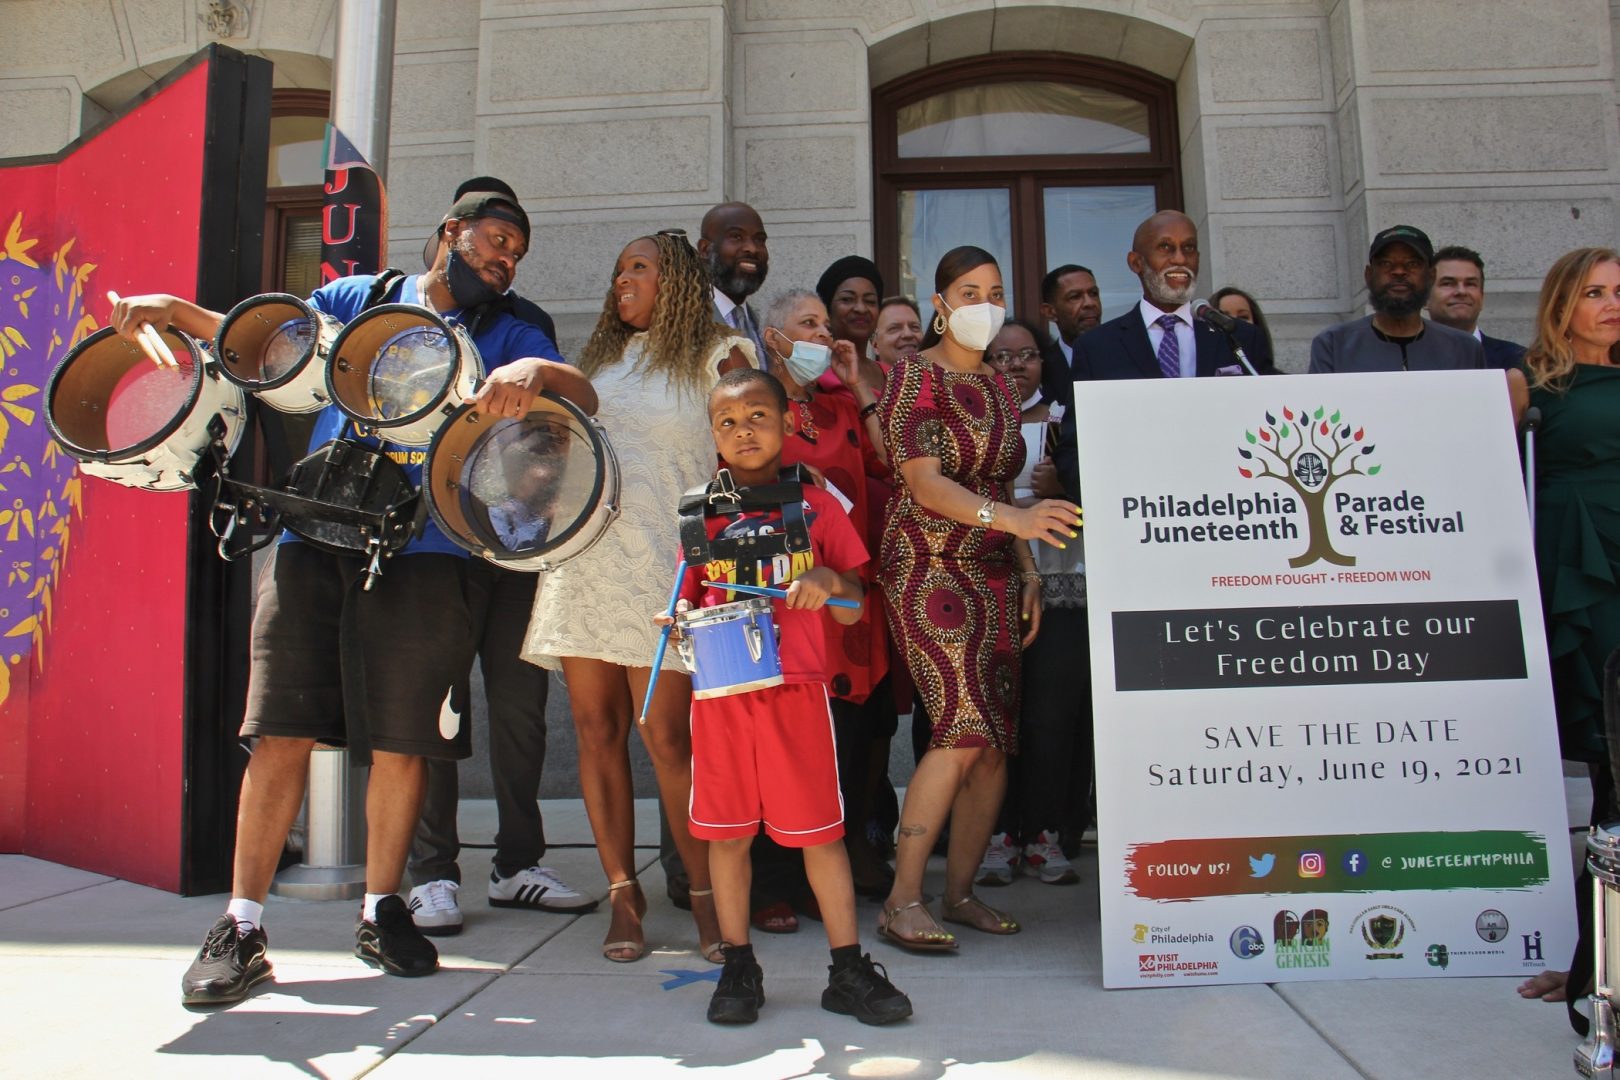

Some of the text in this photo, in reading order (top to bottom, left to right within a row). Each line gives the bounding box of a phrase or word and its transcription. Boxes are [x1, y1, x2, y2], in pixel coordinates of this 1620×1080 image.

[385, 450, 408, 465] RUM
[1122, 489, 1425, 521] Philadelphia Parade
[1140, 511, 1464, 544] Juneteenth & Festival
[1211, 569, 1431, 588] FREEDOM FOUGHT FREEDOM WON
[1165, 614, 1477, 643] Let's Celebrate our
[1217, 649, 1430, 676] Freedom Day
[1204, 718, 1460, 750] SAVE THE DATE
[1148, 757, 1522, 790] Saturday, June 19, 2021
[1147, 864, 1202, 877] FOLLOW
[1208, 862, 1231, 876] US!
[1400, 852, 1535, 871] JUNETEENTHPHILA
[1151, 933, 1214, 944] Philadelphia
[1248, 942, 1265, 951] abc
[1157, 954, 1179, 962] VISIT
[1157, 962, 1218, 971] PHILADELPHIA
[1276, 953, 1330, 968] GENESIS
